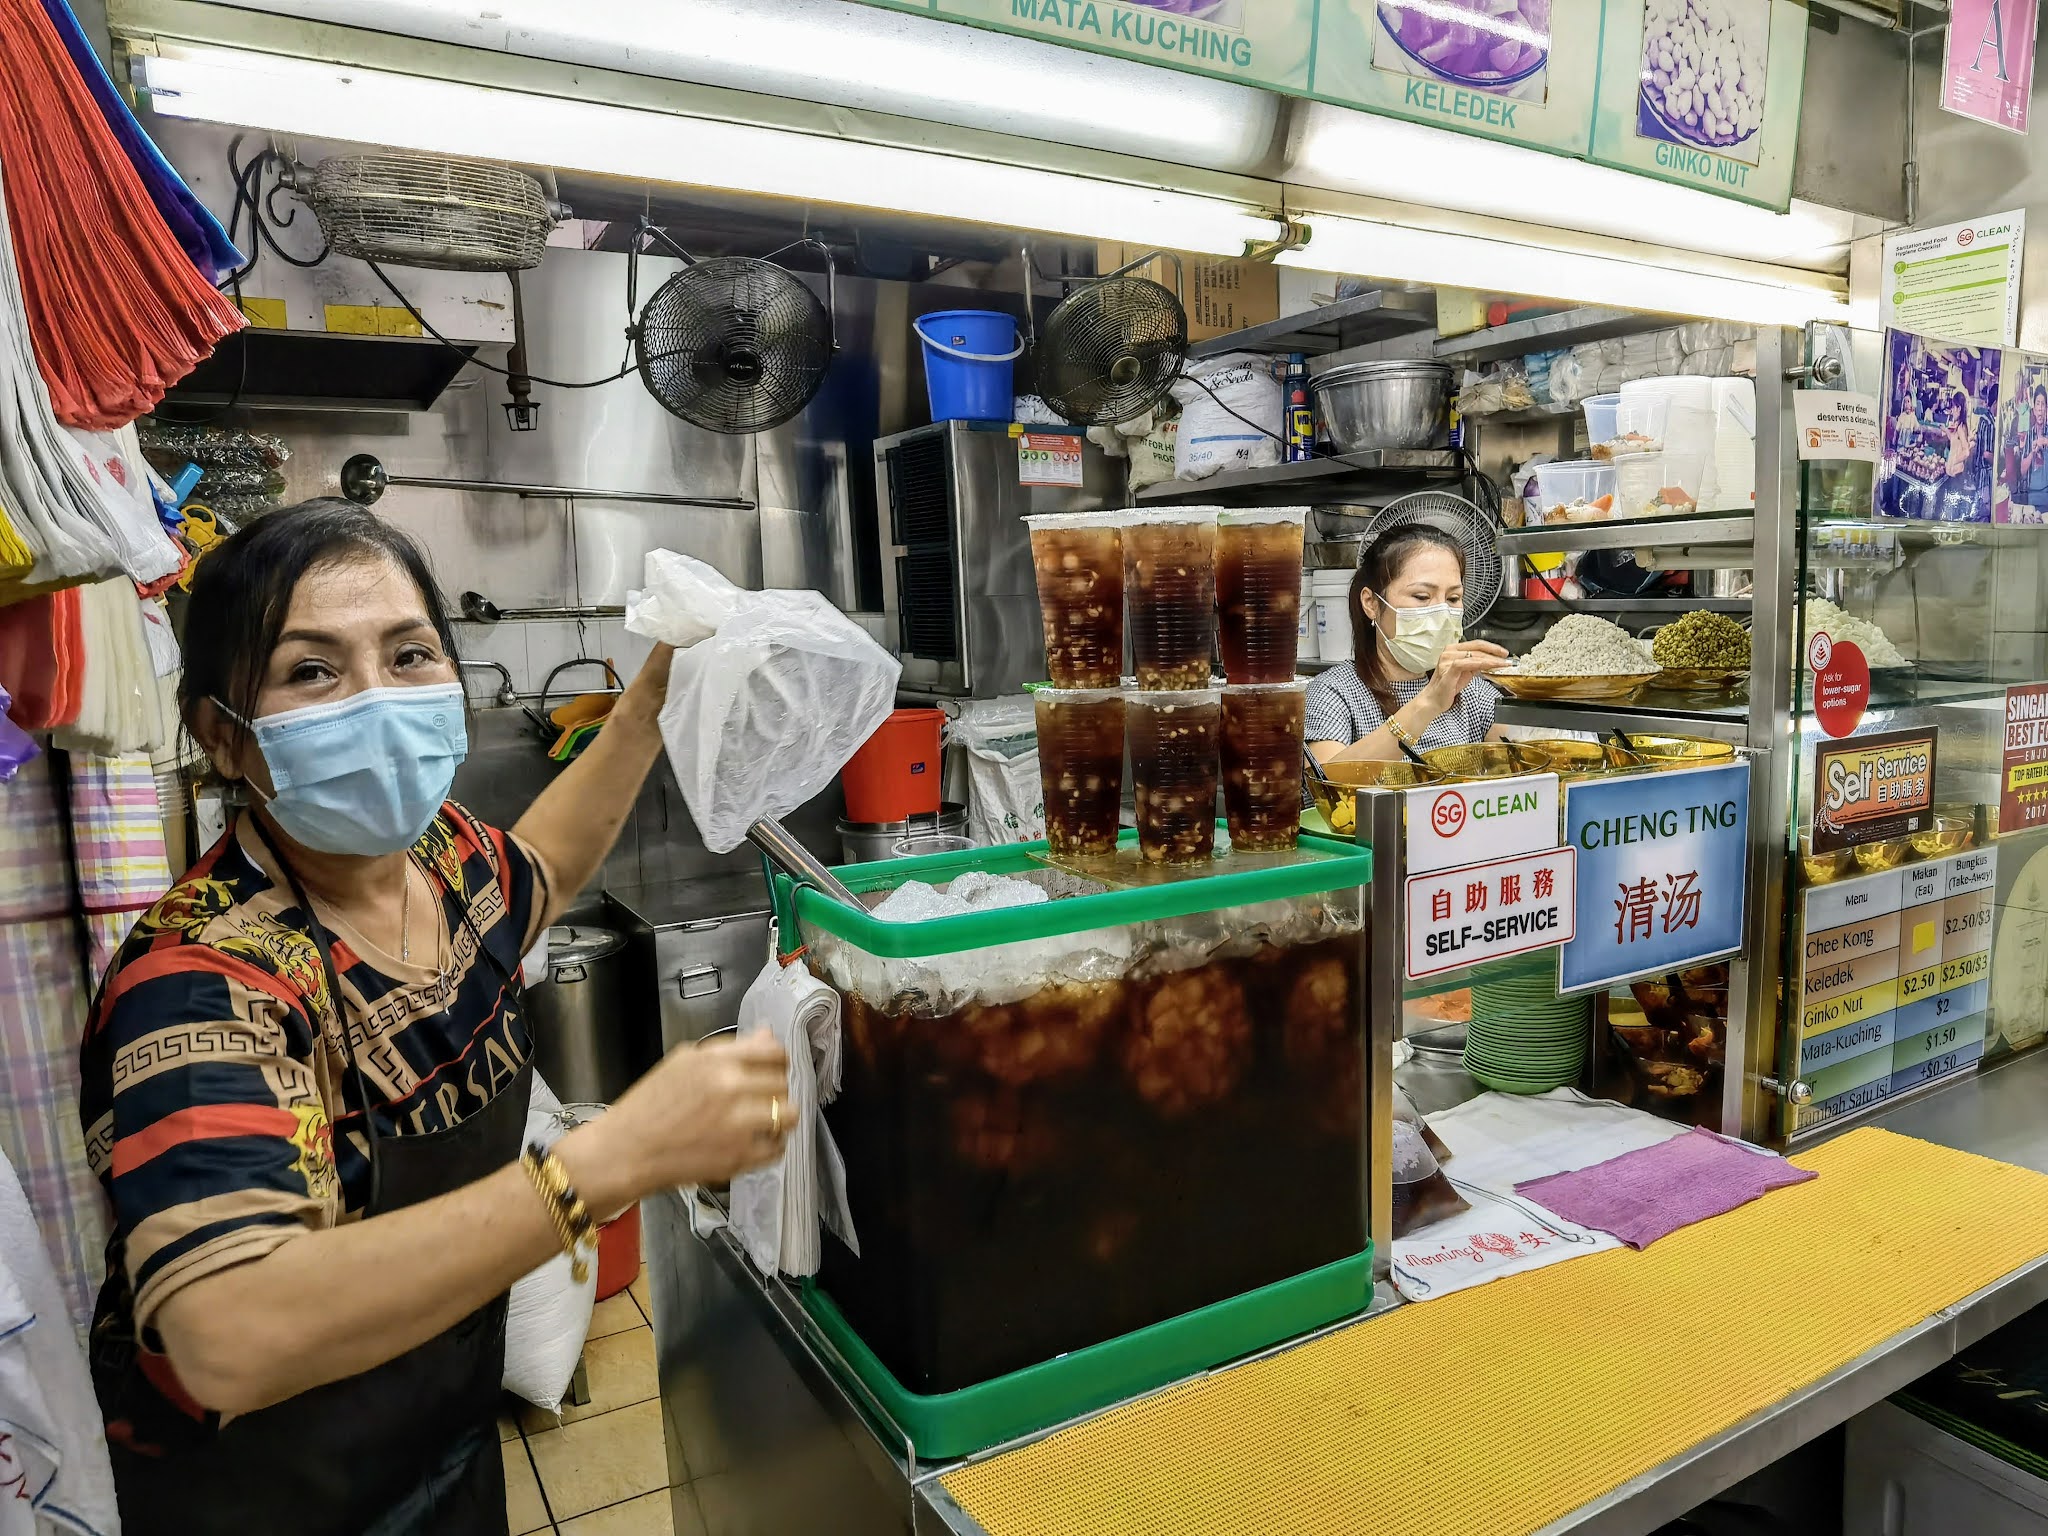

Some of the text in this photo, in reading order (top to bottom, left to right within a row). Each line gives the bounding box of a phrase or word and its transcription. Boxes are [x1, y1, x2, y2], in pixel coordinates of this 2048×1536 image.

[1011, 0, 1252, 67] MATA KUCHING
[1405, 79, 1518, 129] KELEDEK
[1655, 142, 1750, 189] GINKO NUT
[1895, 242, 1922, 252] Sanitation
[1933, 235, 1948, 244] Food
[1976, 224, 2011, 239] CLEAN
[1817, 412, 1850, 423] deserves
[1836, 402, 1855, 414] Every
[1822, 683, 1862, 696] lower-sugar
[1823, 672, 1843, 683] Ask for
[1822, 697, 1847, 710] options
[2007, 723, 2036, 748] BEST
[1828, 752, 1927, 812] Self Service
[2014, 768, 2025, 782] TOP
[2025, 766, 2043, 780] RATED
[1472, 791, 1538, 820] CLEAN
[1877, 778, 1926, 804] 自助服务
[1580, 800, 1737, 851] CHENG TNG
[2025, 804, 2047, 820] 2017
[1432, 867, 1555, 923] 自助服務
[1845, 855, 1988, 907] Menu Makan Bungkus
[1914, 869, 1994, 899] (Eat) (Take-Away)
[1613, 869, 1703, 945] 清汤
[1425, 906, 1559, 957] SELF-SERVICE
[1806, 909, 1991, 959] Chee Kong $2.50/$3
[1805, 955, 1988, 996] Keledek $2.50 $2.50/$3
[1804, 995, 1950, 1028] Ginko Nut $2
[1802, 1023, 1956, 1062] Mata-Kuching $1.50
[1848, 1089, 1873, 1110] Satu
[1920, 1054, 1957, 1079] +$0.50
[1405, 1245, 1485, 1267] Morning
